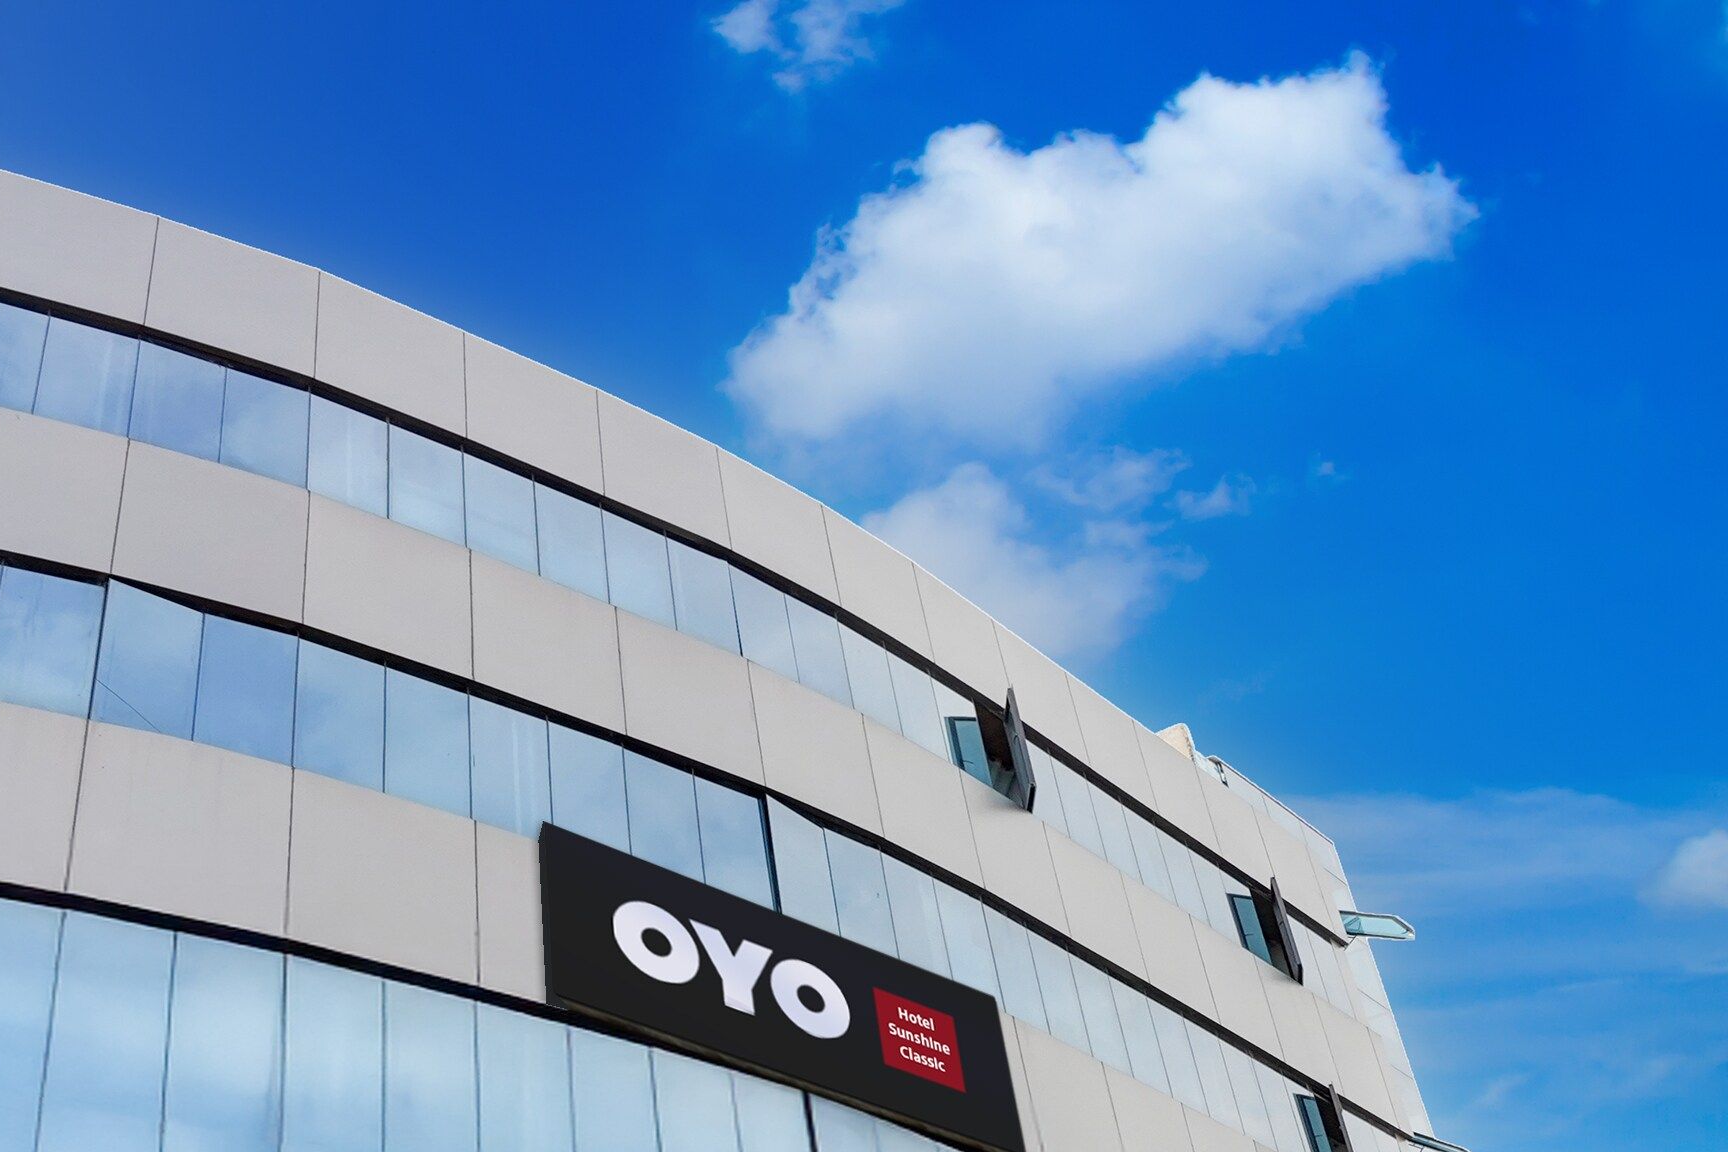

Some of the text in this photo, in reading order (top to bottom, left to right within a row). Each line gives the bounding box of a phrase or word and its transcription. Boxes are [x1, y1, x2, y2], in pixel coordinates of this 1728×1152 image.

[613, 901, 850, 1039] OYO
[898, 1007, 935, 1031] Hotel
[888, 1022, 951, 1056] Sunshine
[899, 1045, 946, 1072] Classic
